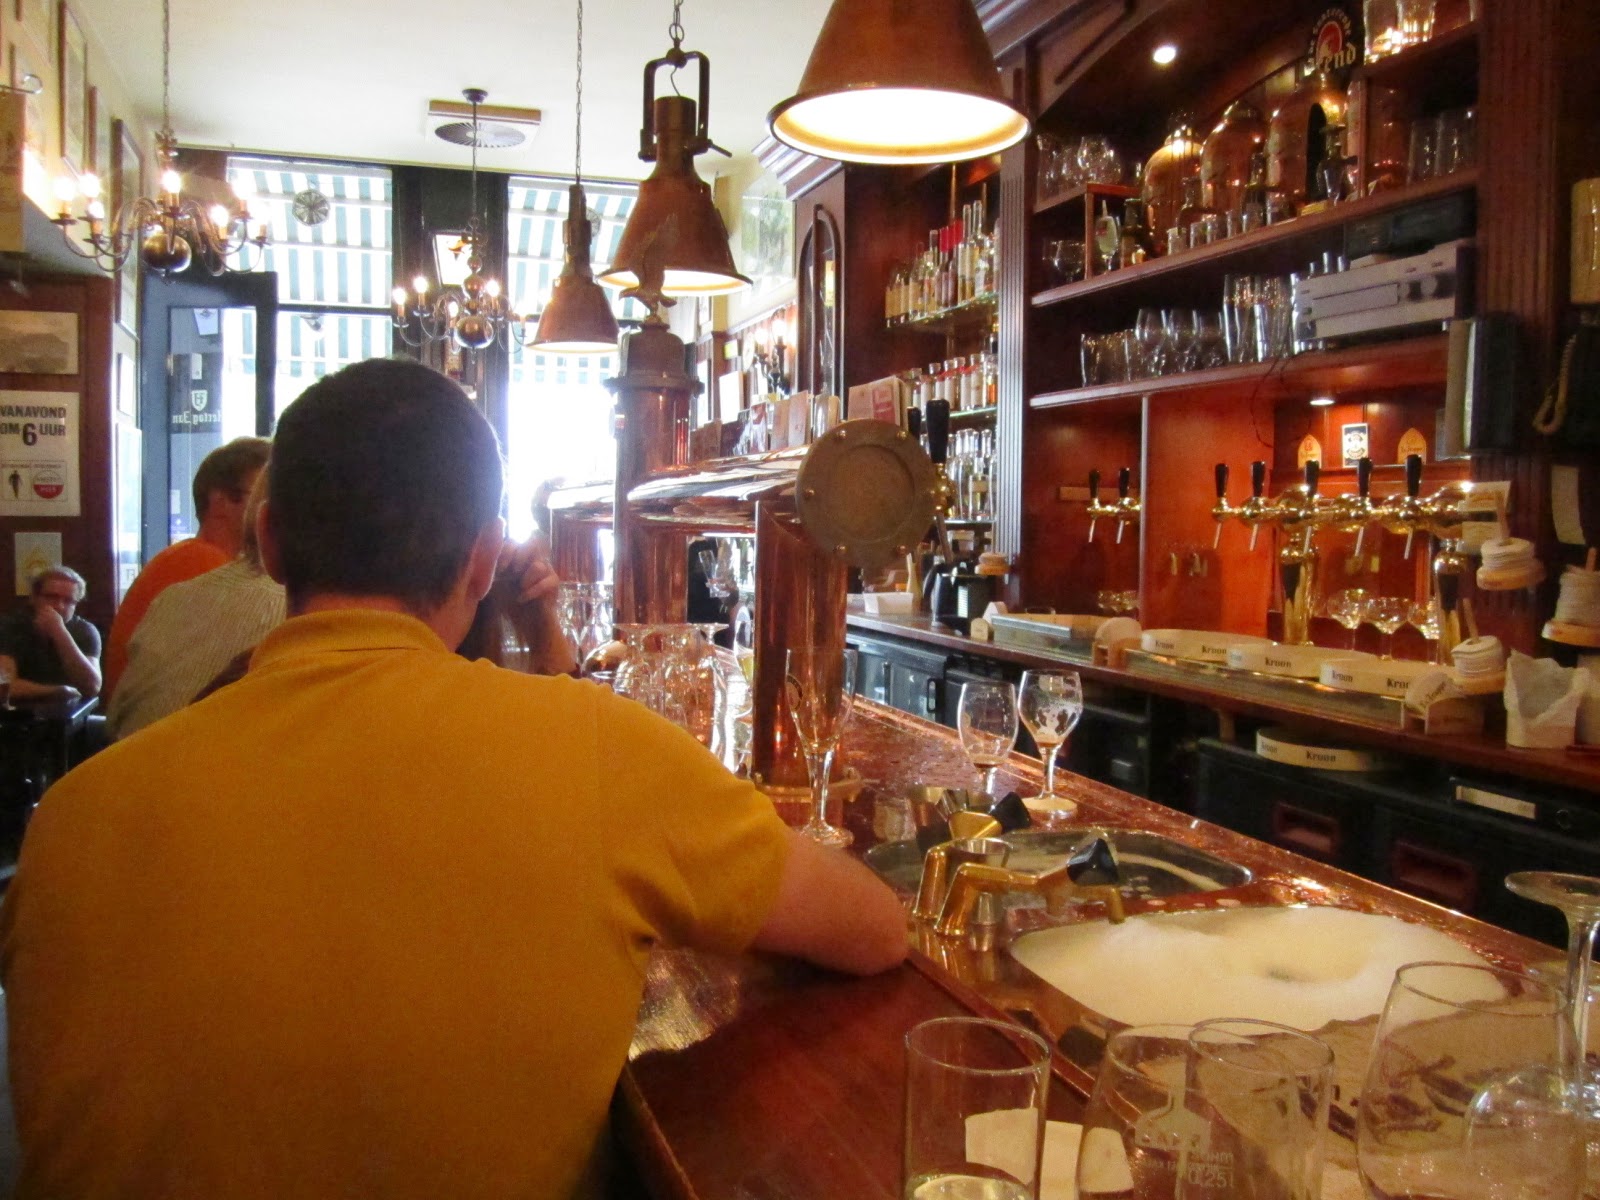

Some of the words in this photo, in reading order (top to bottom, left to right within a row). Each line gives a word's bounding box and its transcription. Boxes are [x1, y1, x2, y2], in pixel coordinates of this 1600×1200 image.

[0, 404, 67, 419] VANAVOND
[0, 422, 20, 435] OM
[22, 422, 38, 447] 6
[40, 423, 66, 436] UUR
[1201, 645, 1227, 655] Kroon
[1265, 656, 1291, 668] Kroon
[1386, 678, 1410, 689] Kro
[1306, 750, 1336, 762] Kroon
